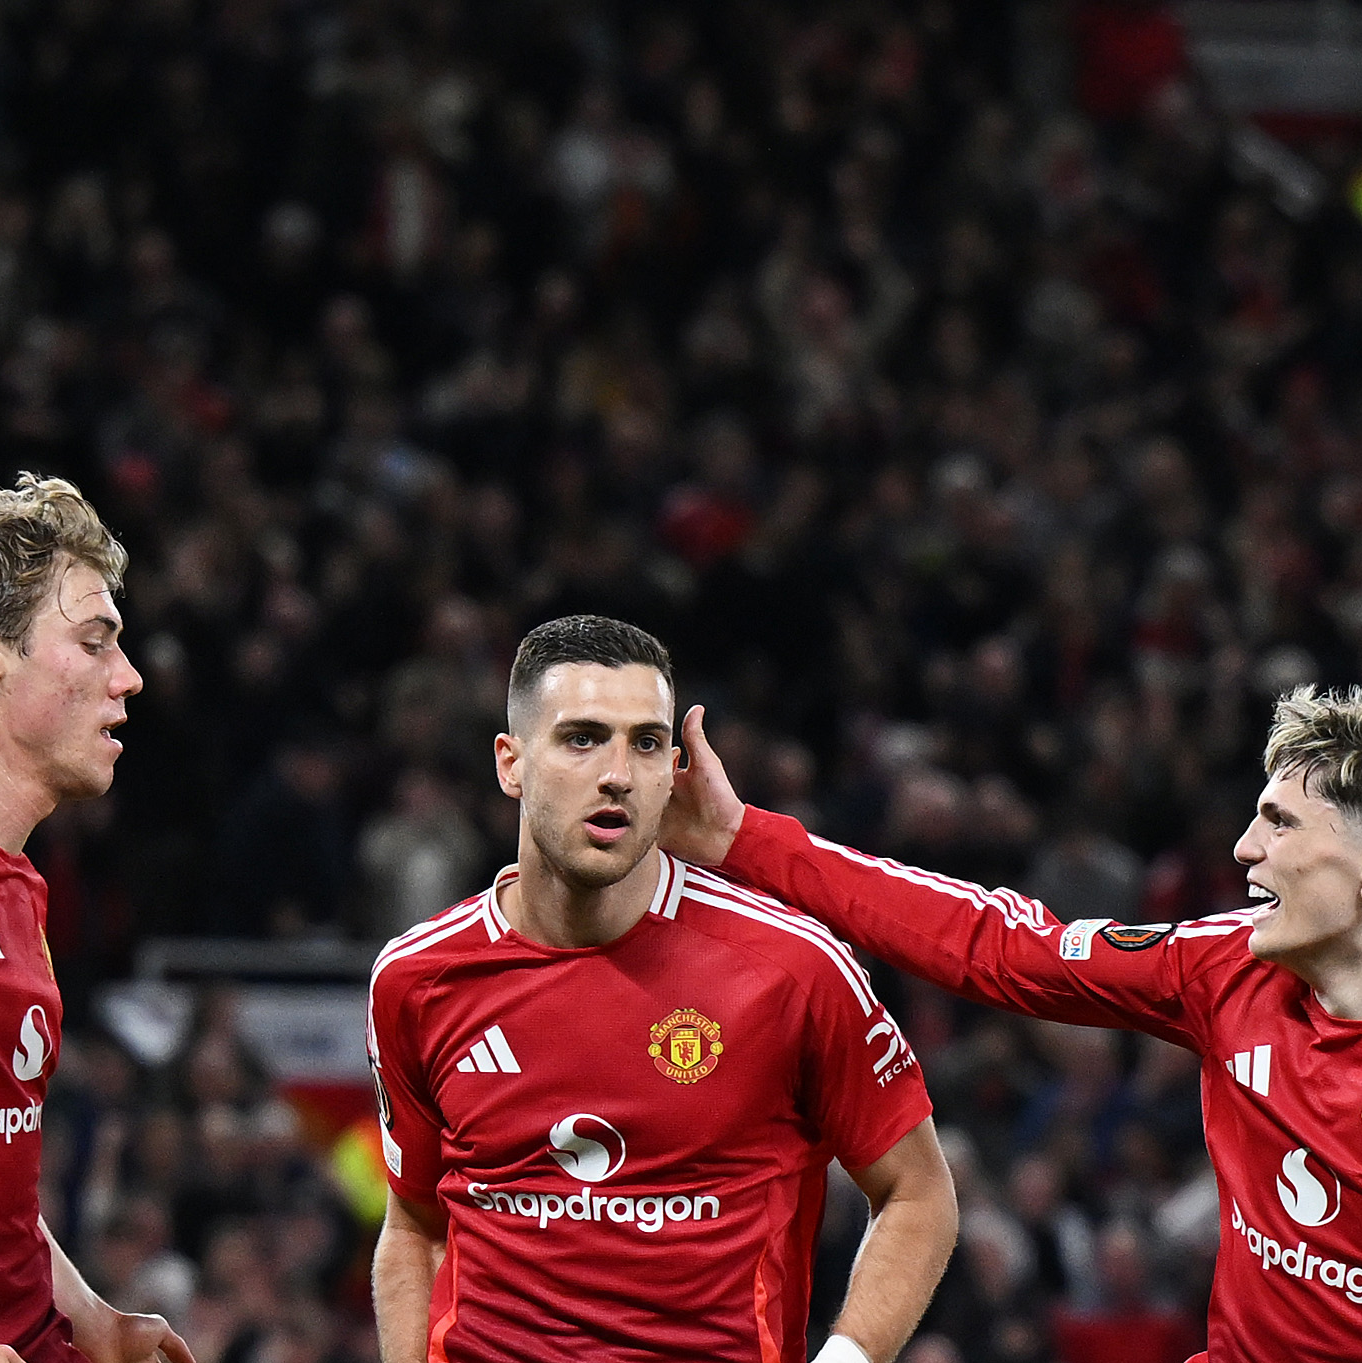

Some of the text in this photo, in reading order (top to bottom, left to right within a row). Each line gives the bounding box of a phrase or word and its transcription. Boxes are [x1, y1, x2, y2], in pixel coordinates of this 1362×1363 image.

[655, 1014, 717, 1039] MANCHESTER
[665, 1065, 709, 1079] UNITED
[467, 1182, 720, 1233] Snapdragon
